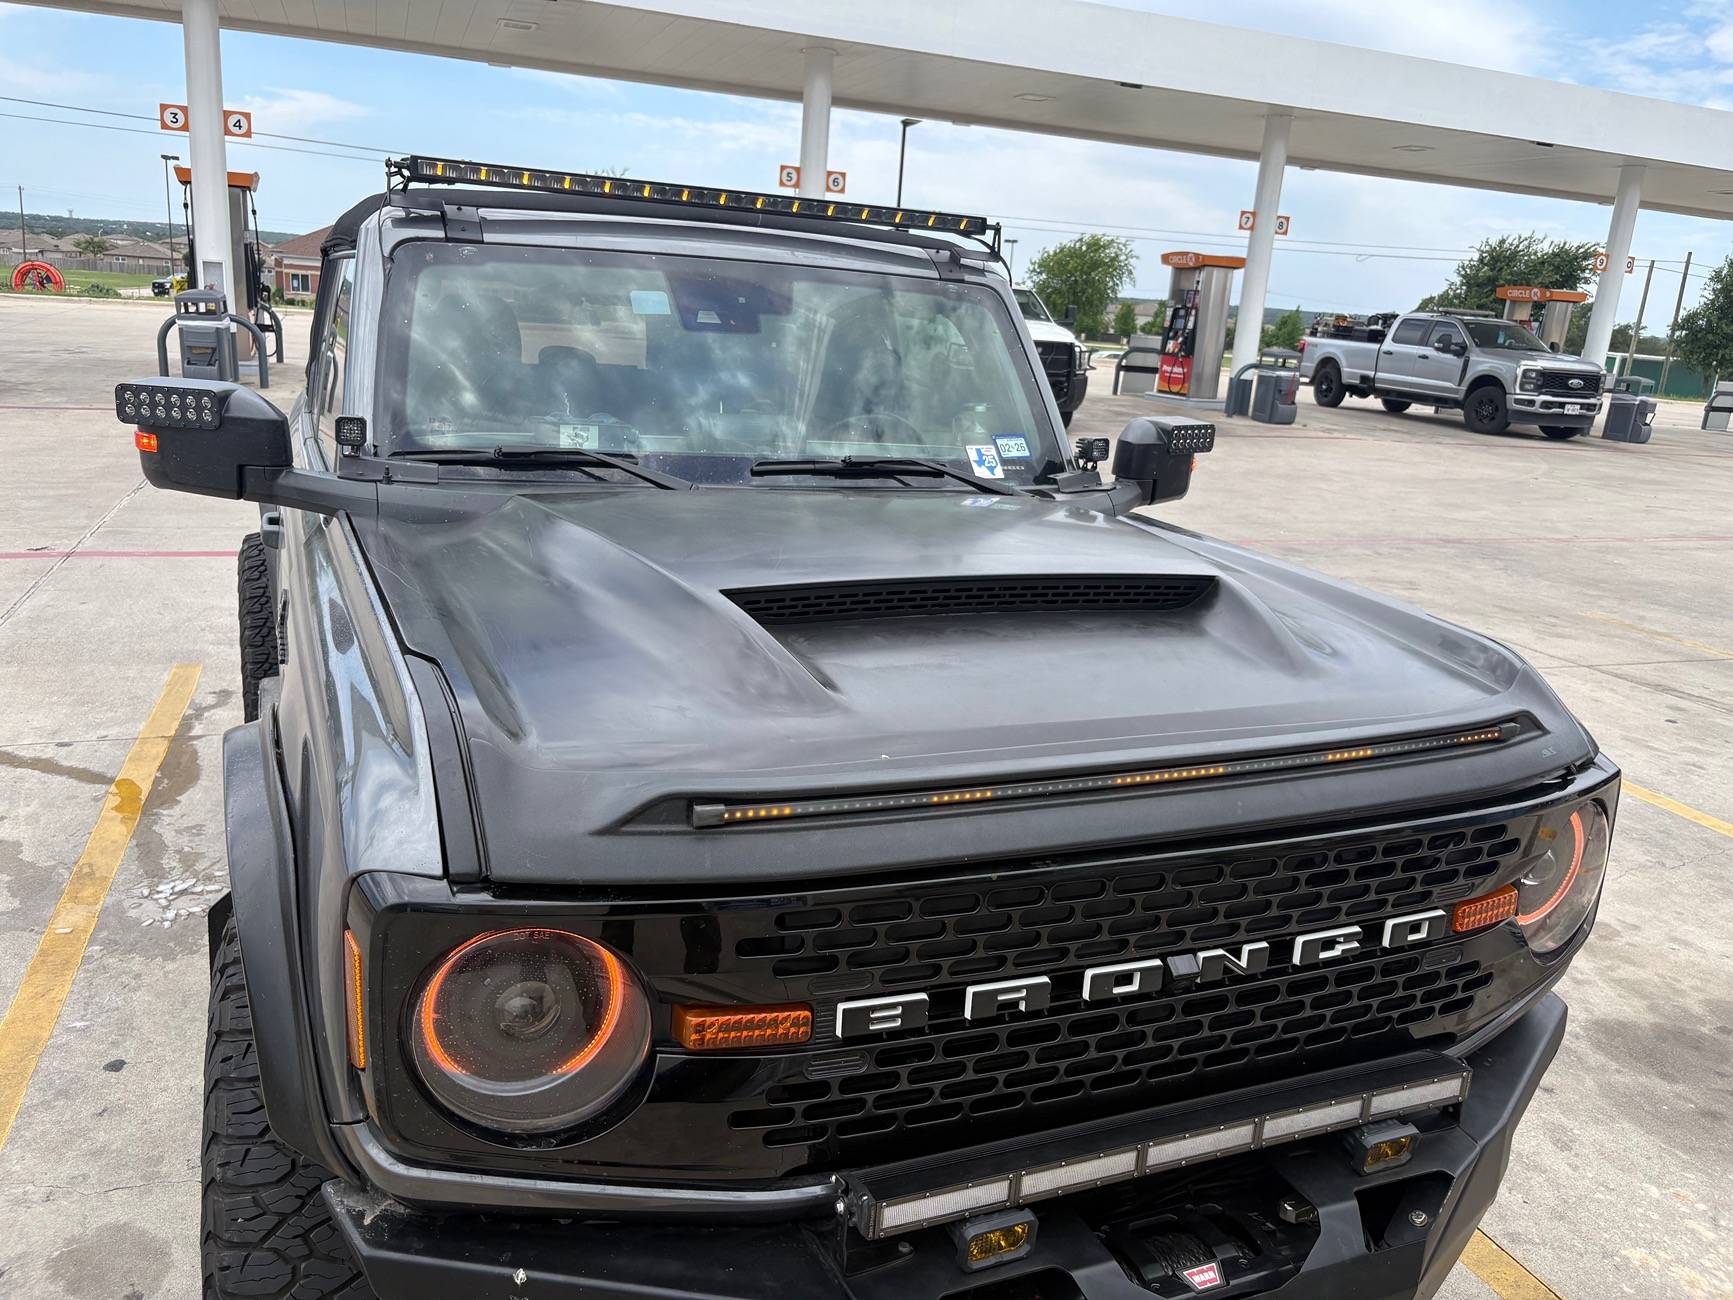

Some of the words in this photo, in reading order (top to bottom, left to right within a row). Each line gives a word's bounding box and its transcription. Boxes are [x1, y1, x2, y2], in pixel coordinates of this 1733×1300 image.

[169, 112, 179, 124] 3
[232, 118, 242, 130] 4
[785, 171, 793, 182] 5
[832, 177, 840, 187] 6
[1244, 216, 1250, 225] 7
[1277, 221, 1284, 230] 8
[1168, 255, 1187, 264] CIRCLE
[1598, 257, 1605, 266] 9
[1507, 290, 1530, 298] CIRCLE
[1000, 443, 1012, 453] 02
[1014, 442, 1026, 452] 26
[983, 454, 997, 467] 25
[533, 931, 551, 940] SAE
[835, 908, 1447, 1039] BRONCO
[1191, 1270, 1216, 1284] WARN
